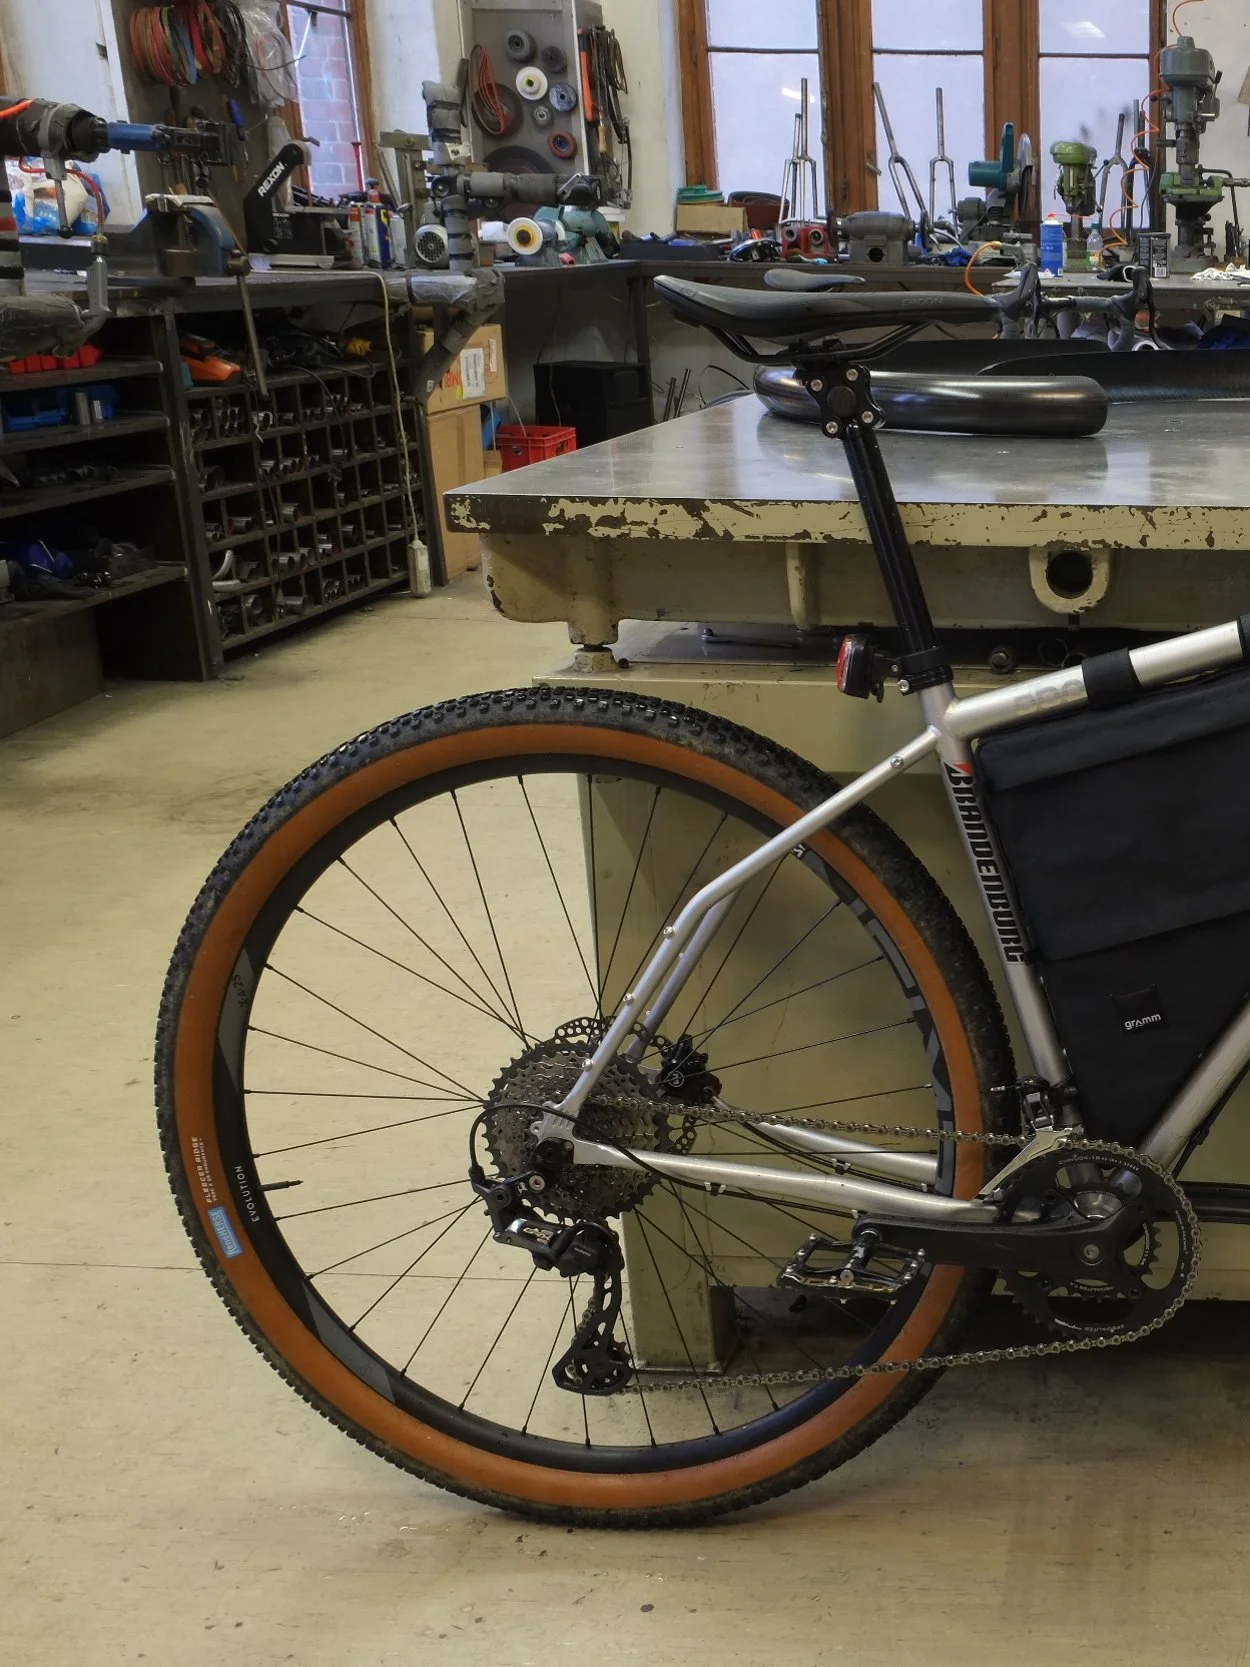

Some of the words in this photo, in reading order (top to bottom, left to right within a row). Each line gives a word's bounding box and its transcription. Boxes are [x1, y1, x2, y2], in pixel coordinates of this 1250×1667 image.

[257, 161, 285, 197] REXON
[944, 762, 1028, 967] BRANDENBURG
[1124, 1013, 1162, 1031] gramm
[191, 1136, 201, 1163] RIDGE
[197, 1165, 212, 1203] FLEECER
[234, 1165, 260, 1222] EVOLUTION
